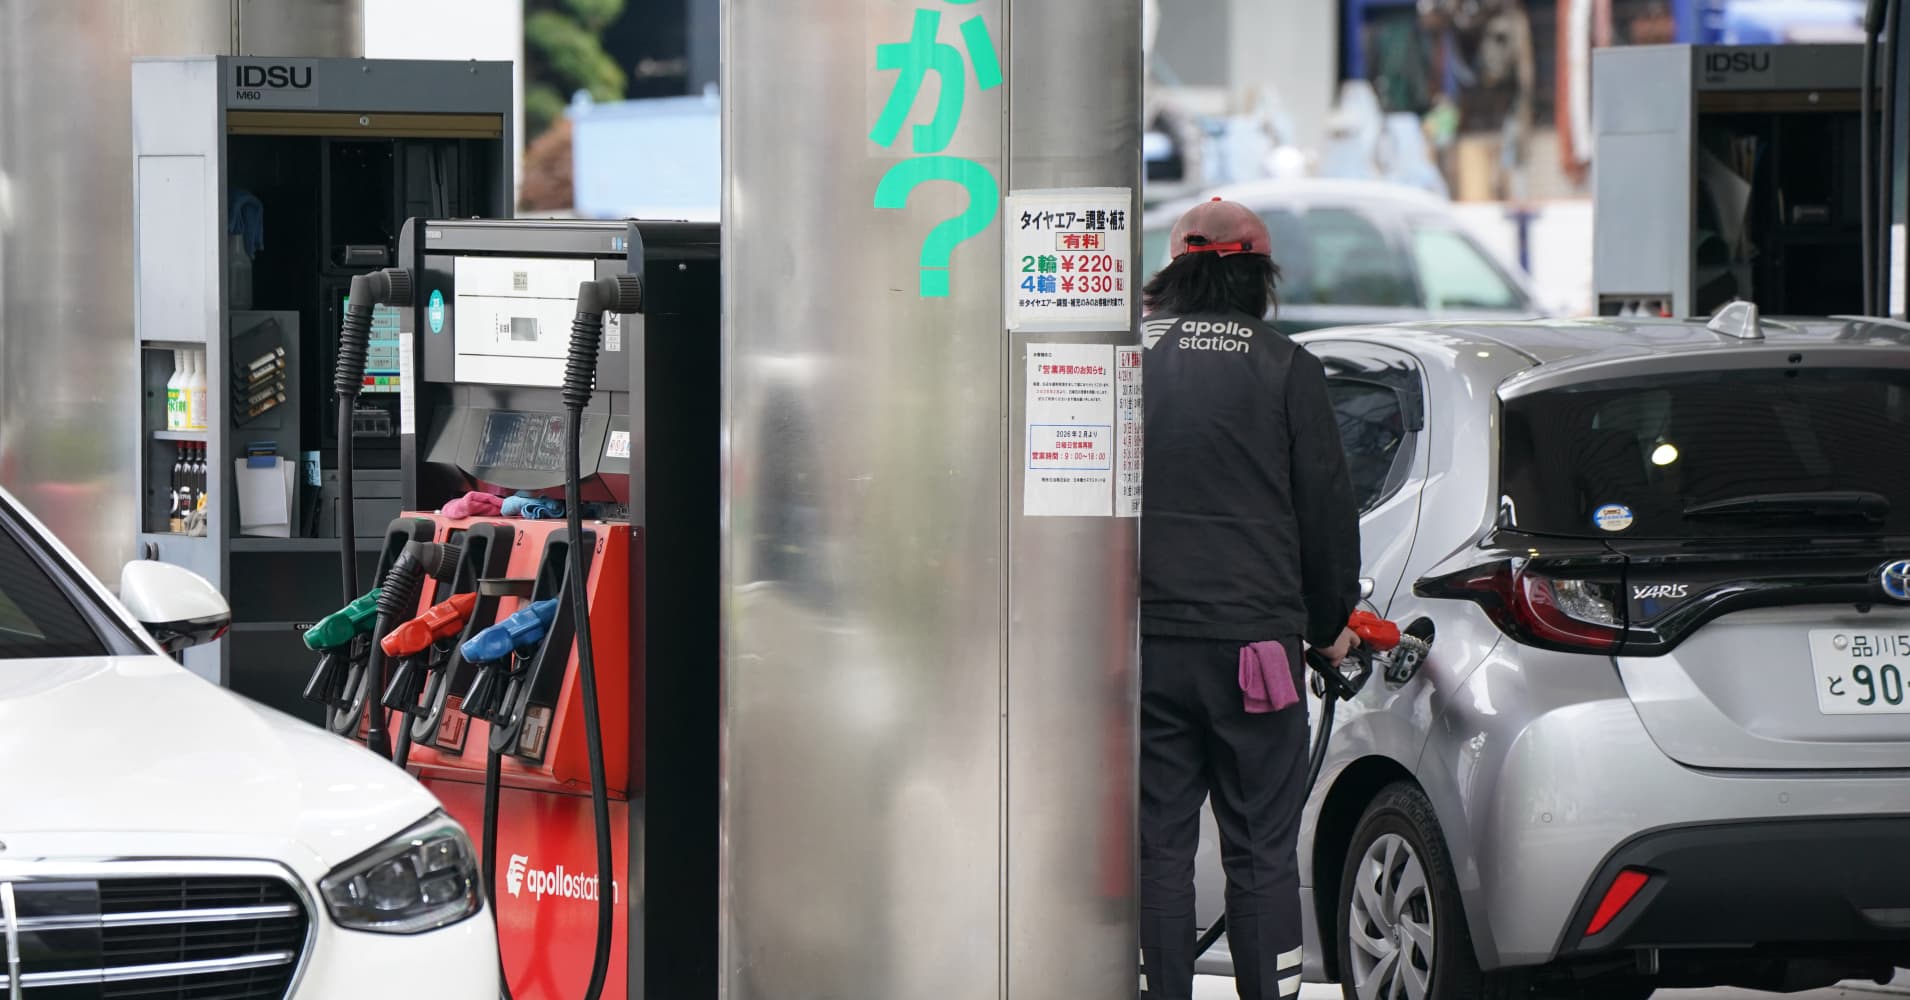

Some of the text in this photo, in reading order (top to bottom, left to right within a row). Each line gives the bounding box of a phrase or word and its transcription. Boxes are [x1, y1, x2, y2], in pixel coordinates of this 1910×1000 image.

[1706, 52, 1769, 72] IDSU
[236, 65, 312, 88] IDSU
[236, 91, 261, 100] M60
[868, 0, 1003, 297] か?
[1020, 209, 1125, 231] タイヤエアー調整・補充
[1063, 234, 1099, 249] 有料
[1021, 254, 1057, 273] 2輪
[1061, 254, 1112, 273] ¥220
[1020, 275, 1057, 293] 4輪
[1061, 275, 1112, 293] ¥330
[1181, 320, 1253, 338] apollo
[1178, 336, 1250, 353] station
[517, 530, 524, 546] 2
[597, 537, 604, 554] 3
[1632, 584, 1689, 600] YARIS
[1852, 635, 1897, 657] 品川
[1827, 675, 1845, 696] と
[527, 864, 619, 904] apollostatn
